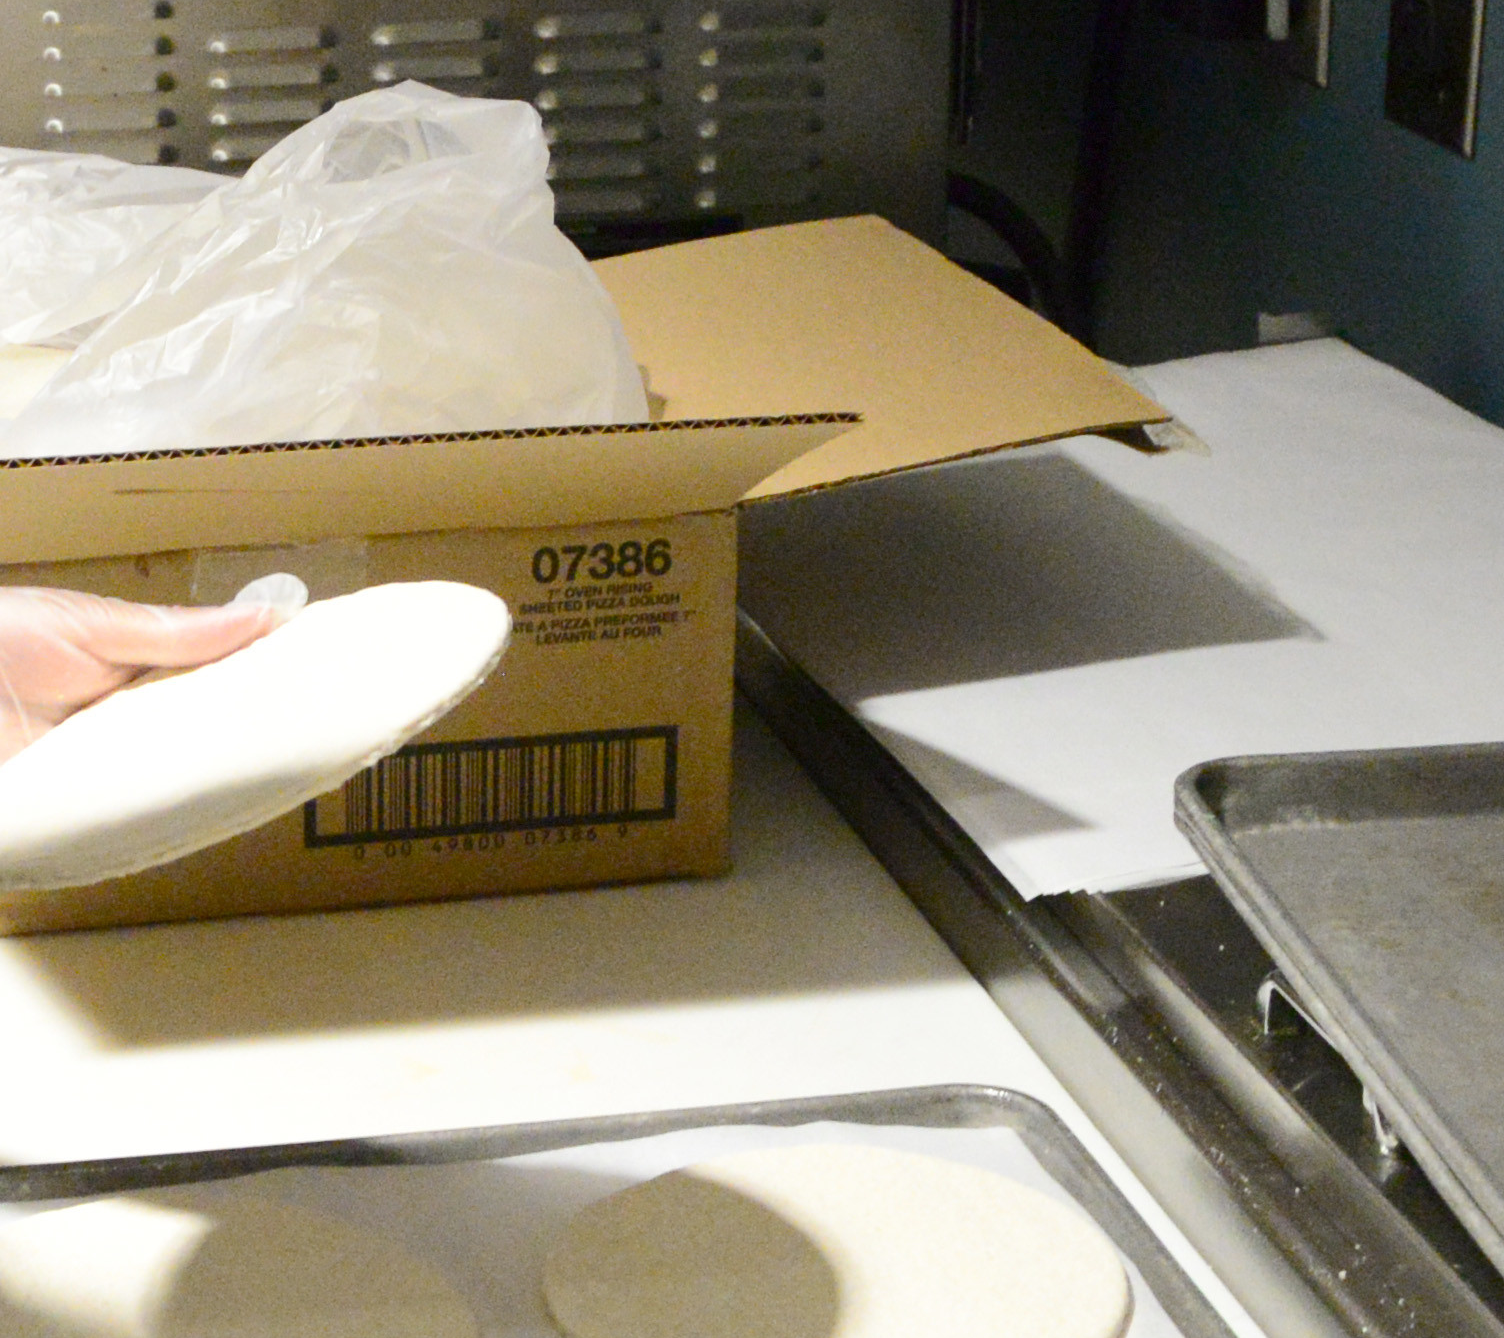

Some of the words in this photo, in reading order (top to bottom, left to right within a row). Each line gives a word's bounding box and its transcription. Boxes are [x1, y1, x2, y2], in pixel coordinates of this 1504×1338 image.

[531, 537, 673, 584] 07386
[564, 585, 602, 599] OVEN
[606, 581, 653, 595] RISING
[519, 599, 583, 615] SHEETED
[586, 596, 625, 611] PIZZA
[629, 592, 680, 608] DOUGH
[550, 616, 591, 630] PIZZA
[536, 630, 596, 646] LEVANTE
[600, 627, 620, 640] AU
[623, 624, 662, 638] FOUR
